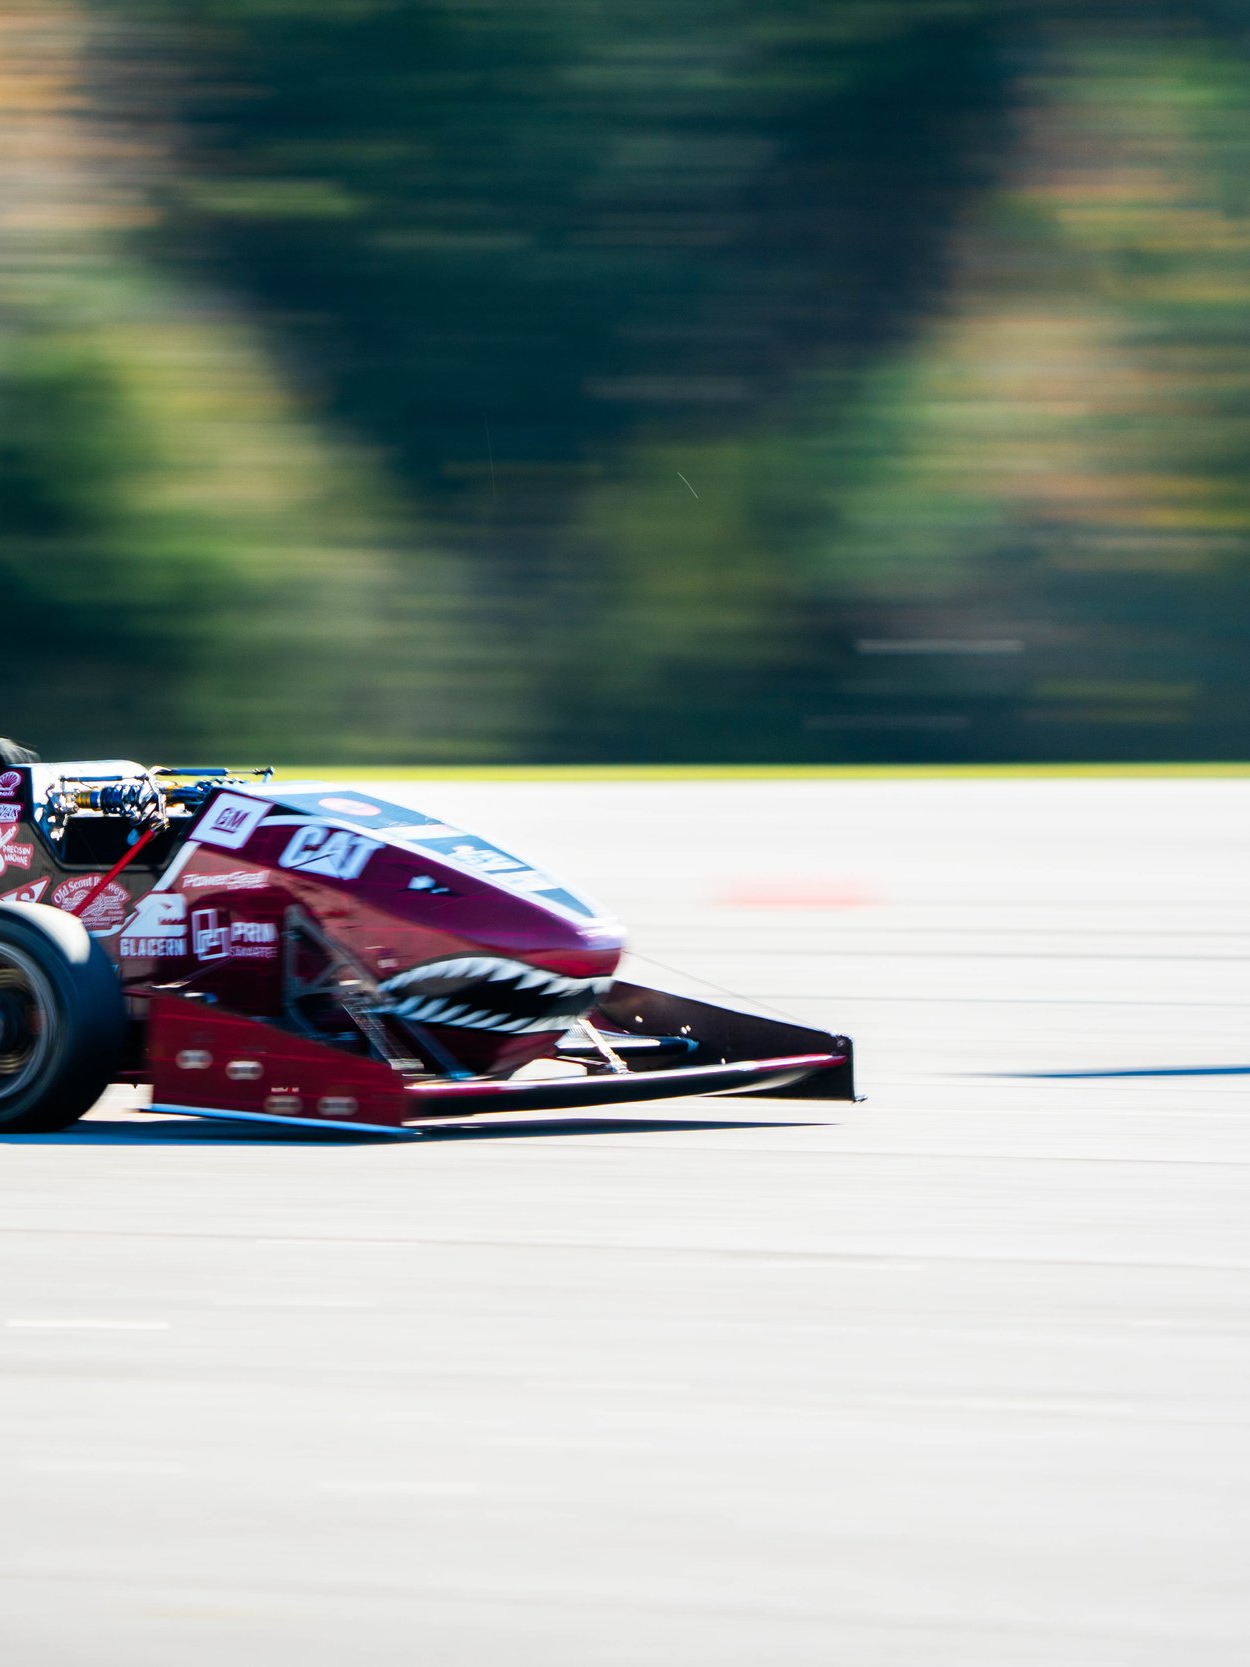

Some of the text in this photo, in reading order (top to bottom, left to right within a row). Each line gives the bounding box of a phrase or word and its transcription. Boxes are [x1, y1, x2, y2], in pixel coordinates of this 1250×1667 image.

[216, 807, 250, 831] GM
[278, 825, 386, 880] CAT
[53, 884, 69, 904] Old
[68, 876, 91, 890] Scout
[120, 938, 187, 957] GLACERN
